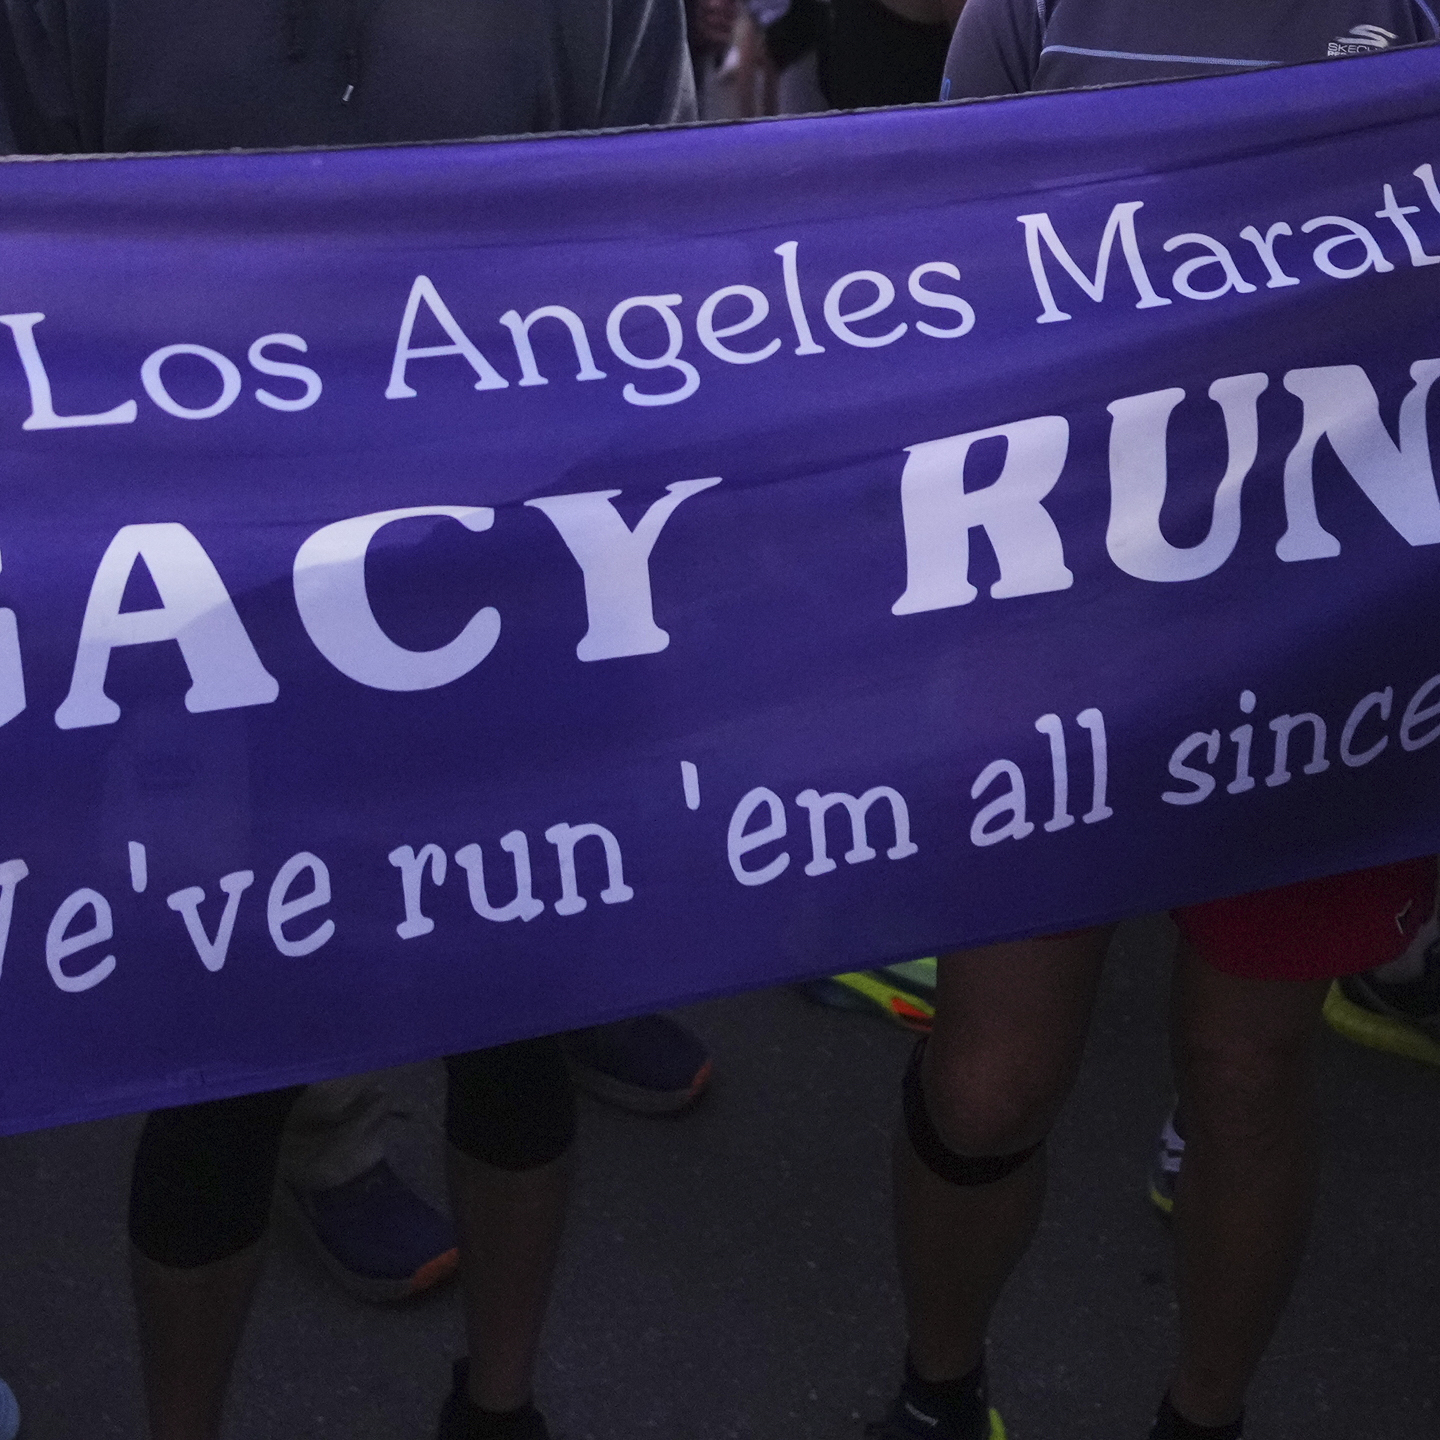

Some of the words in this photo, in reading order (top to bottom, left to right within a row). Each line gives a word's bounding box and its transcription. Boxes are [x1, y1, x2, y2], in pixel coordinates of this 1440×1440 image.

[384, 241, 976, 407] Angeles
[388, 822, 634, 940] run
[680, 760, 918, 886] 'em
[970, 707, 1113, 847] all
